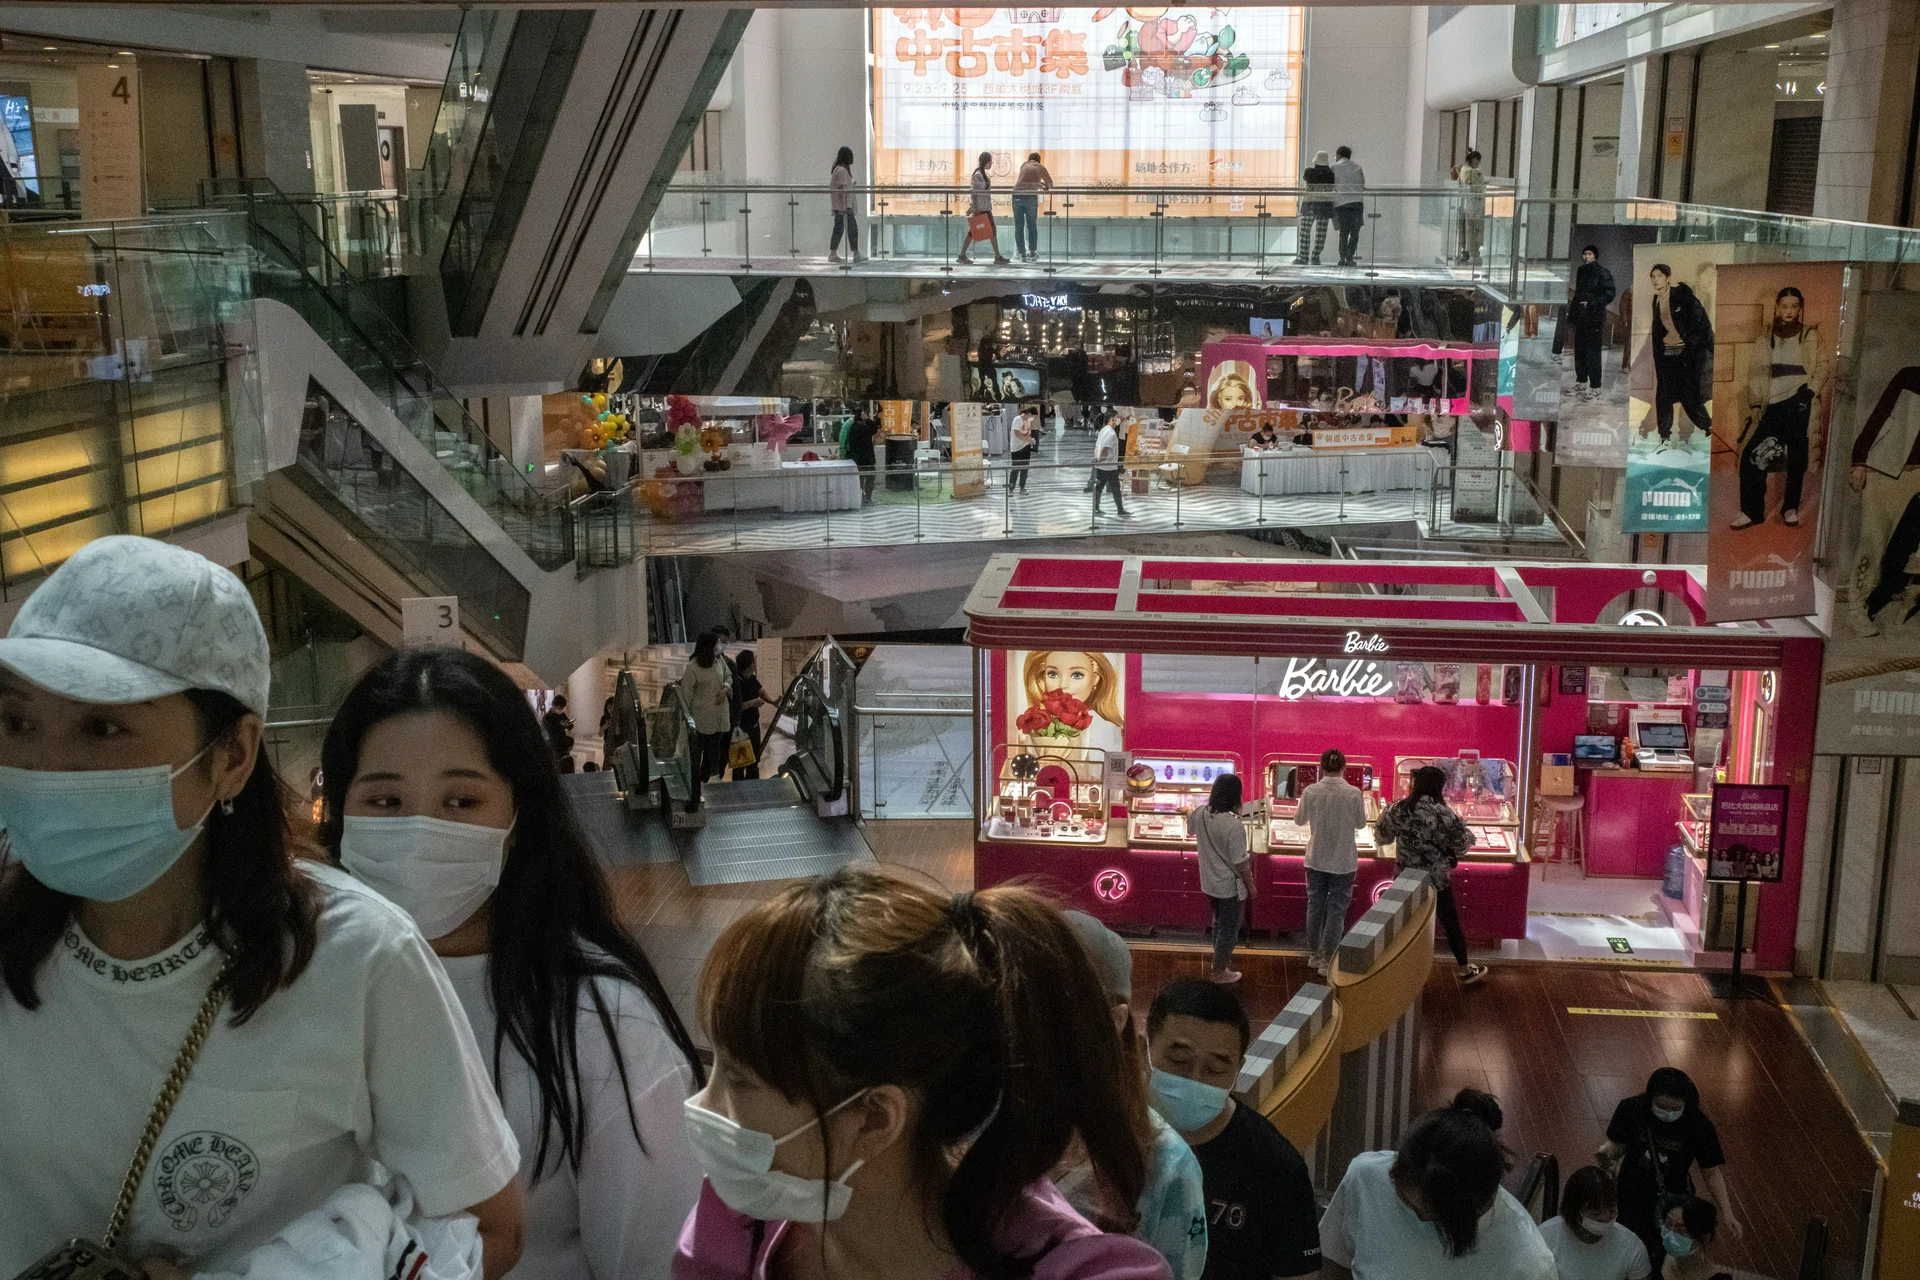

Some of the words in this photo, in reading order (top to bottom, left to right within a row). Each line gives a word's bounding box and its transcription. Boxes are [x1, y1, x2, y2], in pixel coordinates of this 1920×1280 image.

[896, 28, 1089, 79] 中古市集
[111, 75, 131, 105] 4
[1573, 431, 1612, 446] PUMA
[1642, 491, 1691, 507] PUMA
[1729, 569, 1787, 591] PUMA
[438, 604, 453, 629] 3
[1343, 630, 1390, 654] Barbie
[1279, 657, 1394, 700] Barbie
